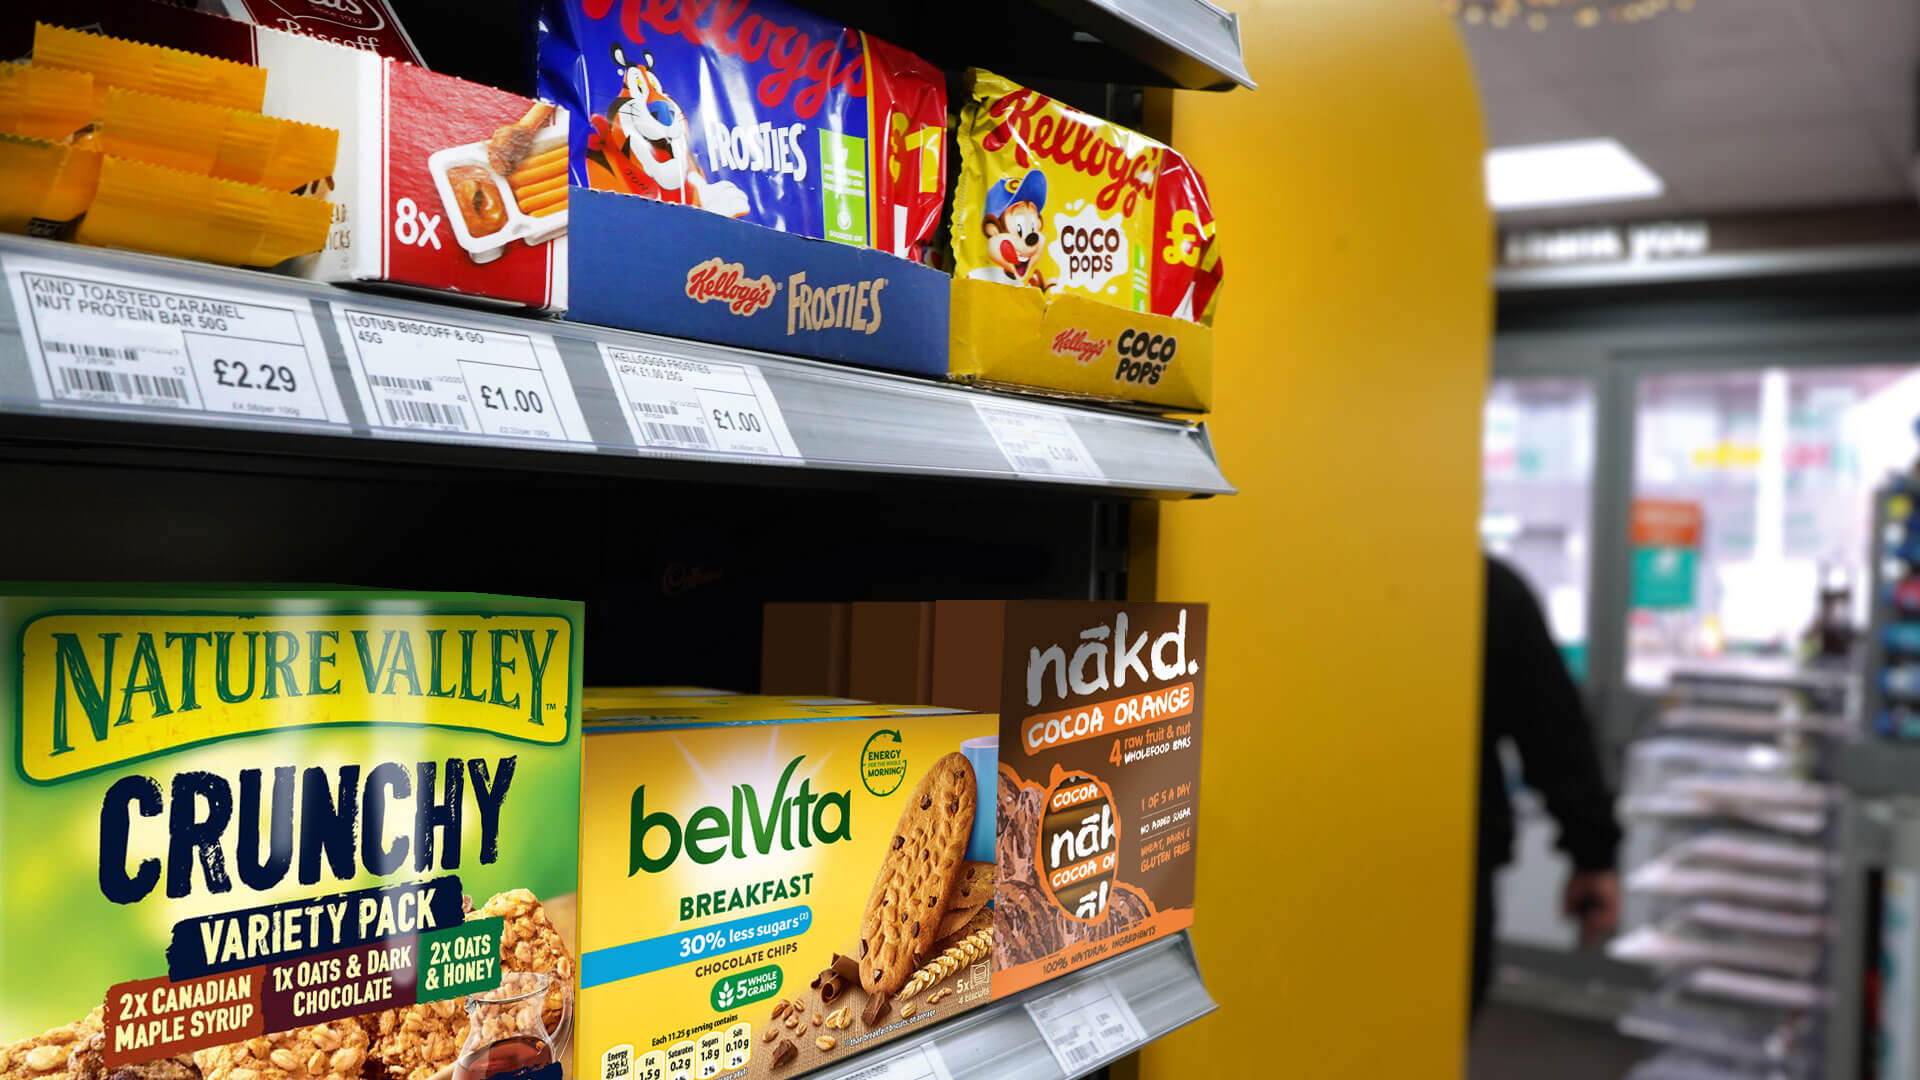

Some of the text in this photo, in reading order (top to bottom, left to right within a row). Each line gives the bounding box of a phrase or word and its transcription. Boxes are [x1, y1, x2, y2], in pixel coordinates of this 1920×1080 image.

[709, 120, 805, 182] FROSTIES
[394, 197, 442, 250] 8x
[31, 277, 245, 320] KIND TOASTED CARAMEL
[687, 263, 772, 314] Kellogg's
[787, 271, 884, 336] FROSTIES
[35, 294, 228, 332] NUT PROTEIN BAR 50G
[351, 316, 485, 344] LOTUS BISCOFF & GO
[358, 332, 383, 344] 45G
[1117, 328, 1177, 363] COCO
[213, 358, 296, 393] £2.29
[1115, 357, 1163, 385] POPS
[480, 385, 544, 414] £1.00
[712, 408, 761, 433] £1.00
[49, 628, 341, 757] NATURE
[350, 628, 559, 726] VALLEY
[1028, 686, 1190, 748] COCOA ORANGE
[1124, 721, 1191, 750] raw fruit & nut
[1124, 736, 1191, 765] WHOLEFOOD BARS
[868, 749, 902, 761] ENERGY
[1109, 739, 1123, 767] 4
[1053, 783, 1098, 808] COCOA
[1147, 791, 1159, 808] OF
[1176, 781, 1192, 798] DAY
[98, 755, 518, 905] CRUNCHY
[628, 755, 852, 878] belVita
[1140, 807, 1191, 835] NO ADDED SUGAR
[1140, 840, 1191, 873] GLUTEN FREE
[1052, 860, 1097, 887] COCOA
[680, 872, 814, 921] BREAKFAST
[200, 886, 438, 966] VARIETY PACK
[454, 934, 492, 959] OATS
[679, 930, 726, 958] 30%
[729, 927, 755, 943] less
[1042, 956, 1068, 975] 100%
[1111, 926, 1157, 949] INGREDIENTS
[297, 958, 341, 986] OATS
[345, 956, 362, 975] &
[366, 945, 412, 975] DARK
[425, 957, 495, 991] & HONEY
[695, 942, 798, 978] CHOCOLATE CHIPS
[736, 979, 748, 999] 5
[747, 970, 777, 986] WHOLE
[747, 981, 777, 997] GRAINS
[957, 979, 970, 994] 5x
[152, 974, 252, 1016] CANADIAN
[293, 977, 393, 1017] CHOCOLATE
[115, 1004, 254, 1052] MAPLE SYRUP
[651, 1035, 667, 1047] Each
[668, 1028, 685, 1041] 11.25
[691, 1021, 713, 1035] serving
[714, 1013, 739, 1028] contains
[701, 1037, 719, 1049] Sugars
[607, 1050, 628, 1062] Energy
[701, 1049, 713, 1061] 1.8
[725, 1039, 743, 1053] 0.10
[645, 1057, 655, 1067] Fat
[670, 1059, 684, 1072] 0.2
